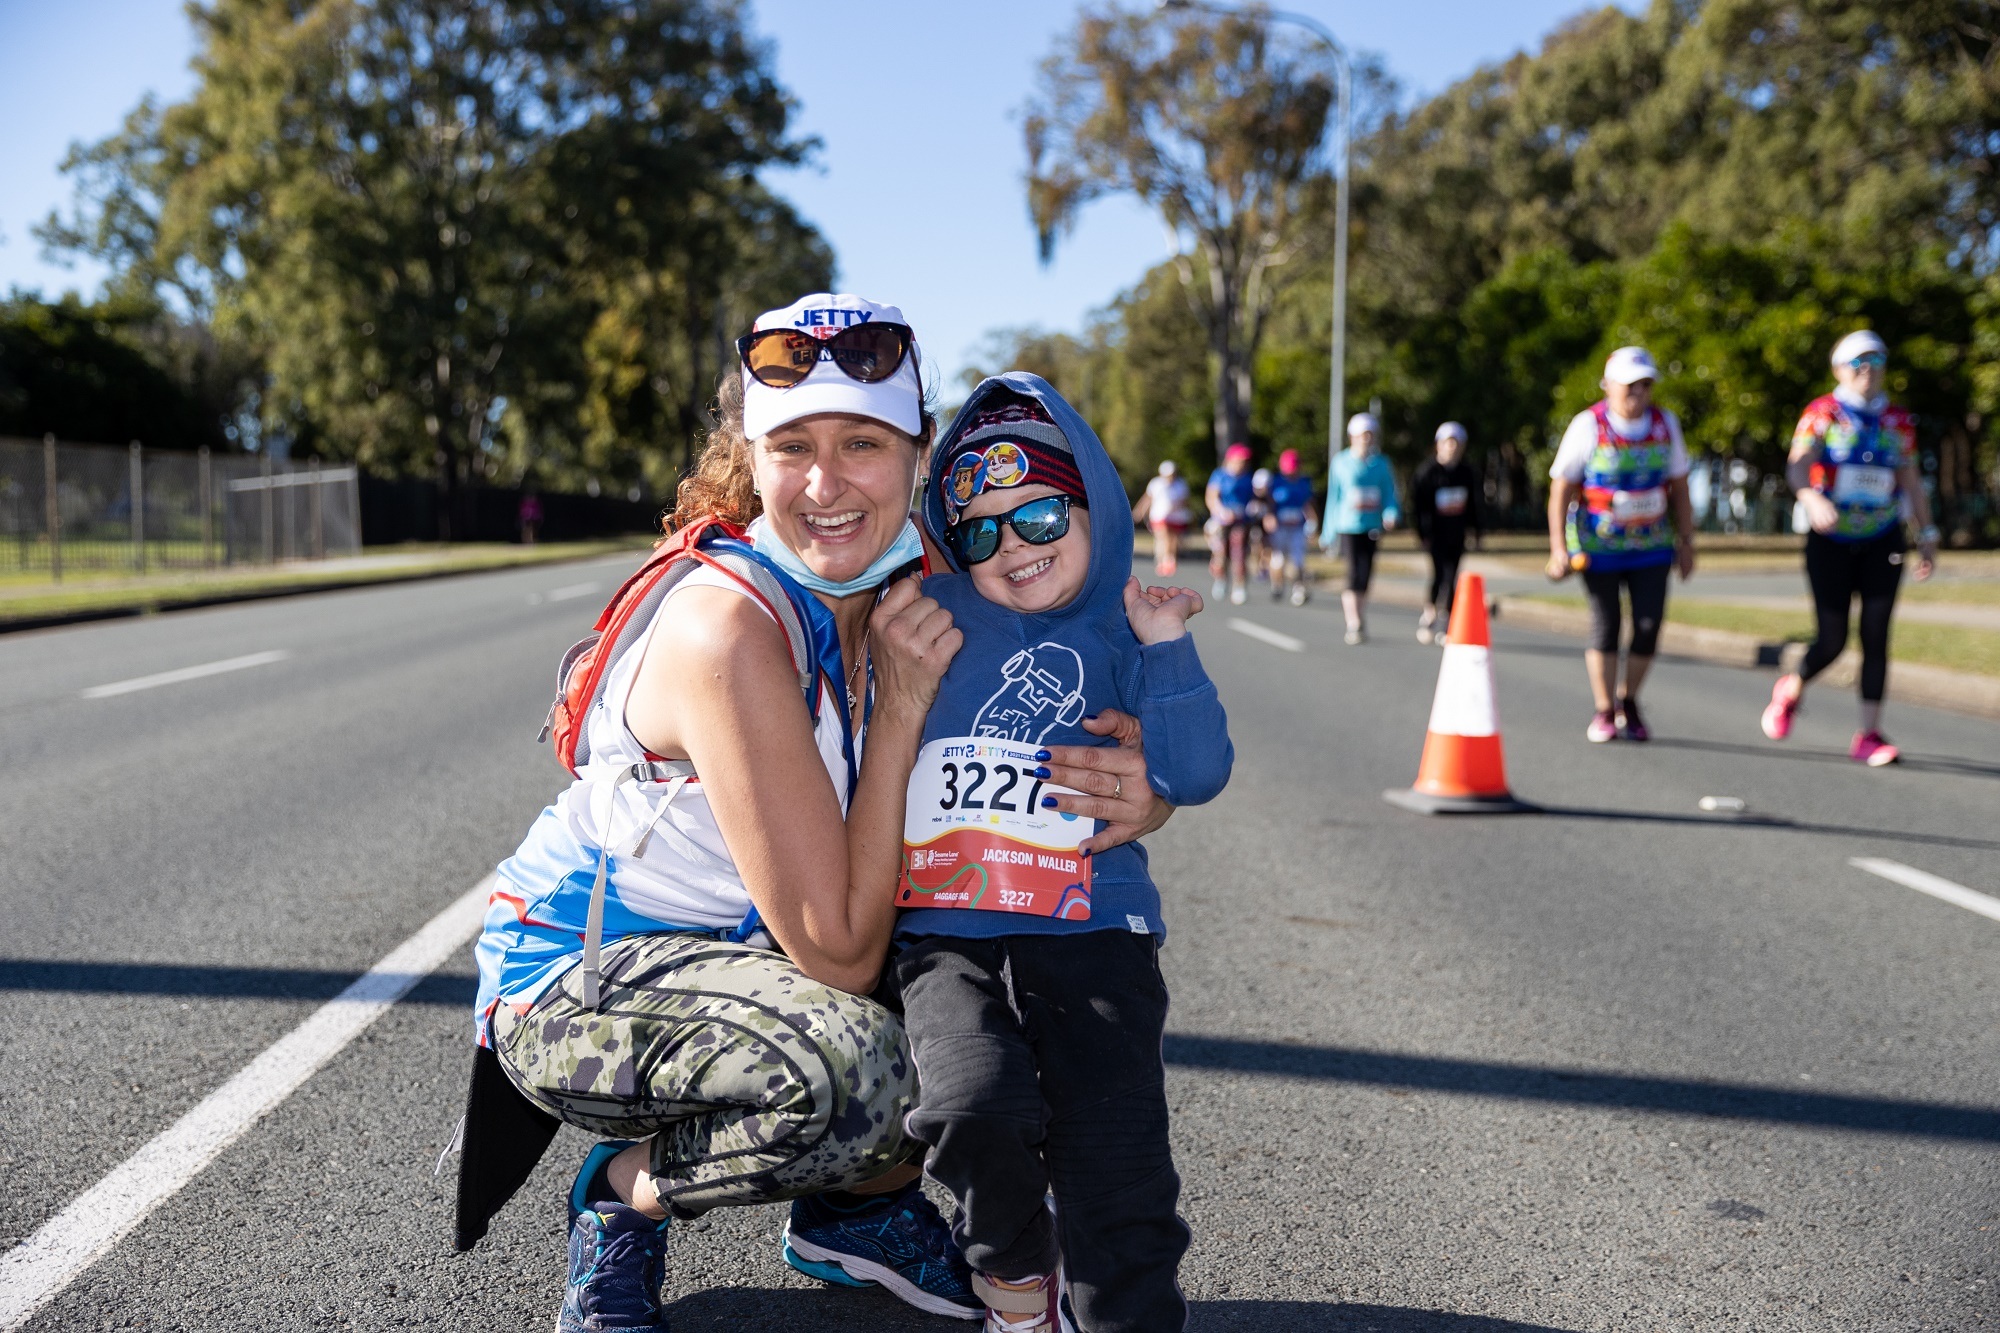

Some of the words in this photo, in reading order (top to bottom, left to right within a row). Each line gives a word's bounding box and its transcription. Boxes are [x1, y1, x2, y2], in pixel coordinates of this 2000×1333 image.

[795, 309, 873, 327] JETTY
[942, 746, 965, 757] JETTY
[975, 745, 1008, 758] JETTY
[939, 761, 1043, 815] 3227
[981, 848, 1034, 866] JACKSON
[1037, 855, 1078, 874] WALLER
[998, 889, 1035, 907] 3227
